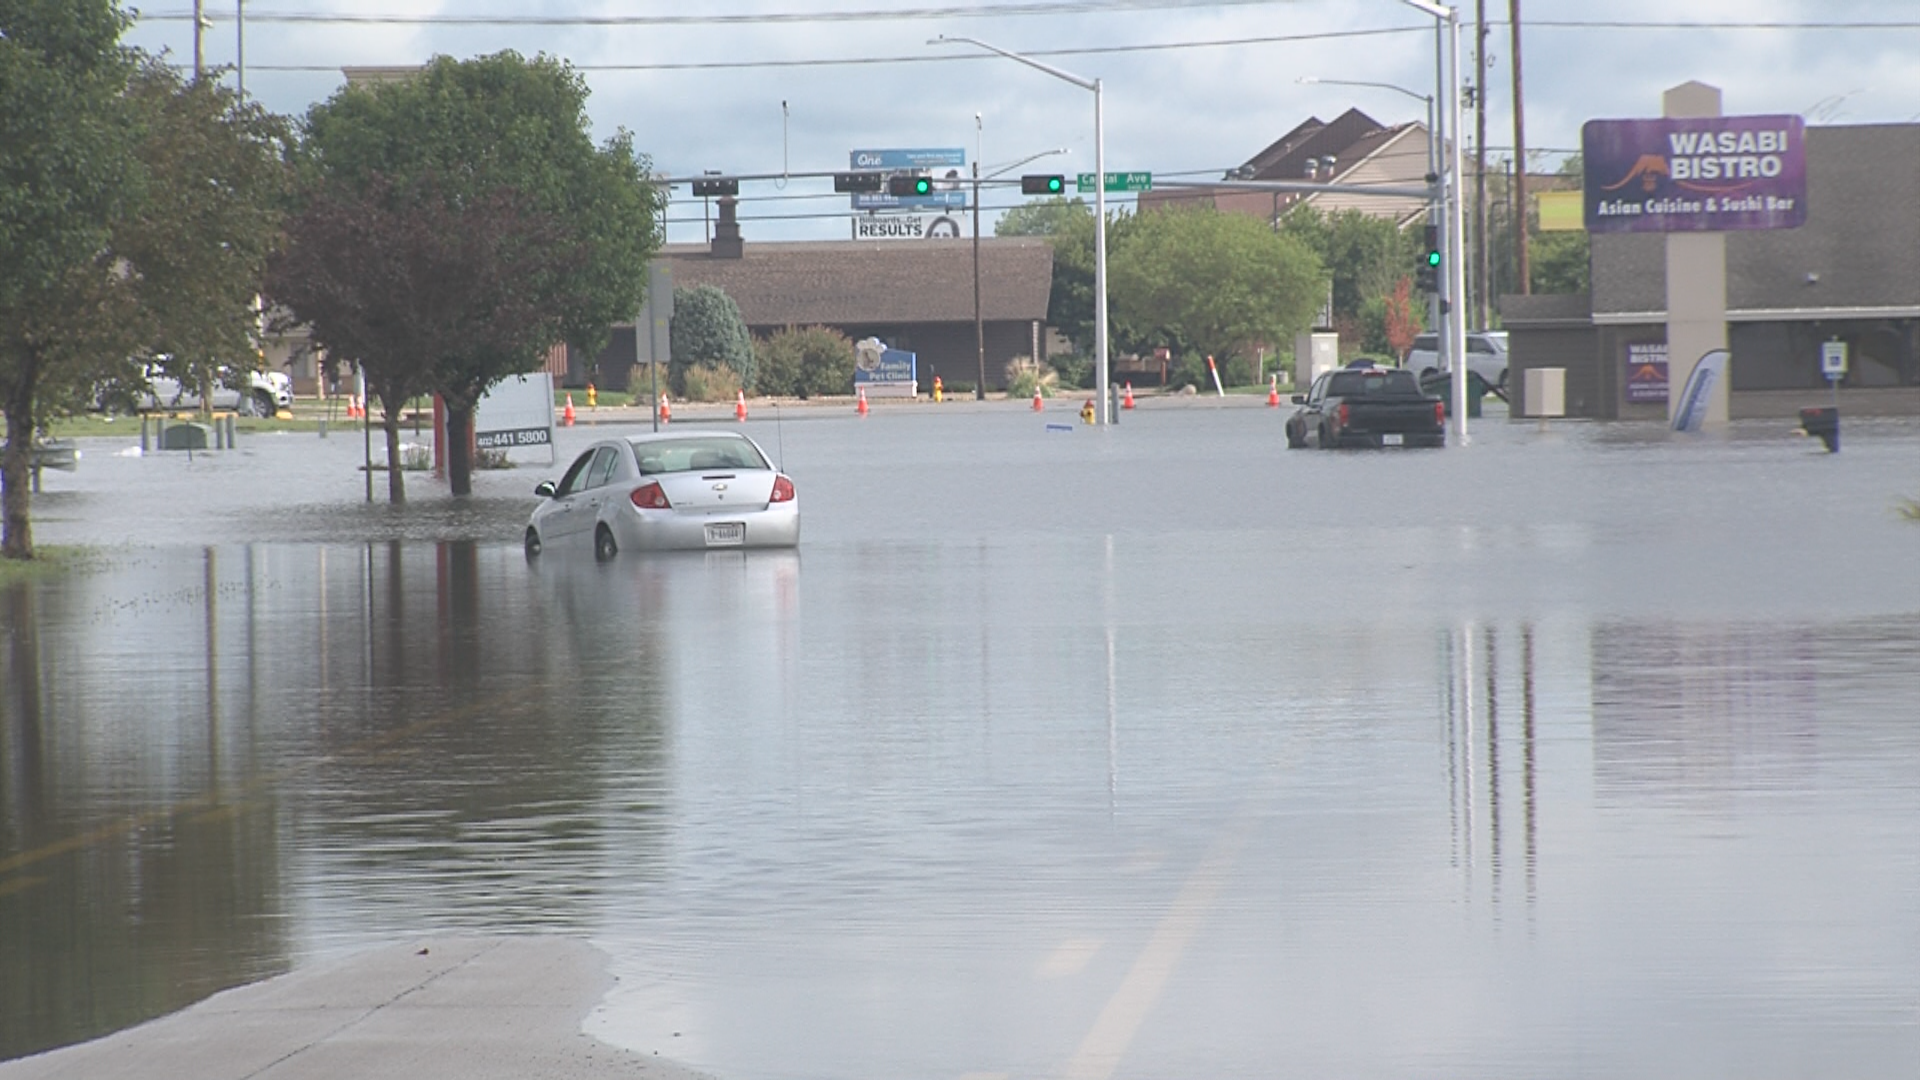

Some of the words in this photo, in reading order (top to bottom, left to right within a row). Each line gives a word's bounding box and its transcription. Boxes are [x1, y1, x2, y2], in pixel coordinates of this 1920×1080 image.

[1669, 131, 1788, 155] WASABI
[858, 153, 882, 166] One
[1670, 155, 1783, 180] BISTRO
[1082, 173, 1117, 185] Catal
[1126, 173, 1147, 183] Ave
[1598, 199, 1641, 215] Asian
[1645, 197, 1700, 214] Cuisine
[1705, 198, 1717, 212] &
[1722, 196, 1762, 212] Sushi
[1767, 196, 1795, 210] Bar
[859, 224, 923, 237] RESULTS
[880, 361, 911, 371] Family
[869, 372, 885, 380] Pet
[886, 371, 910, 380] Clinic
[477, 436, 493, 446] 402
[493, 432, 514, 445] 441
[518, 430, 547, 443] 5800
